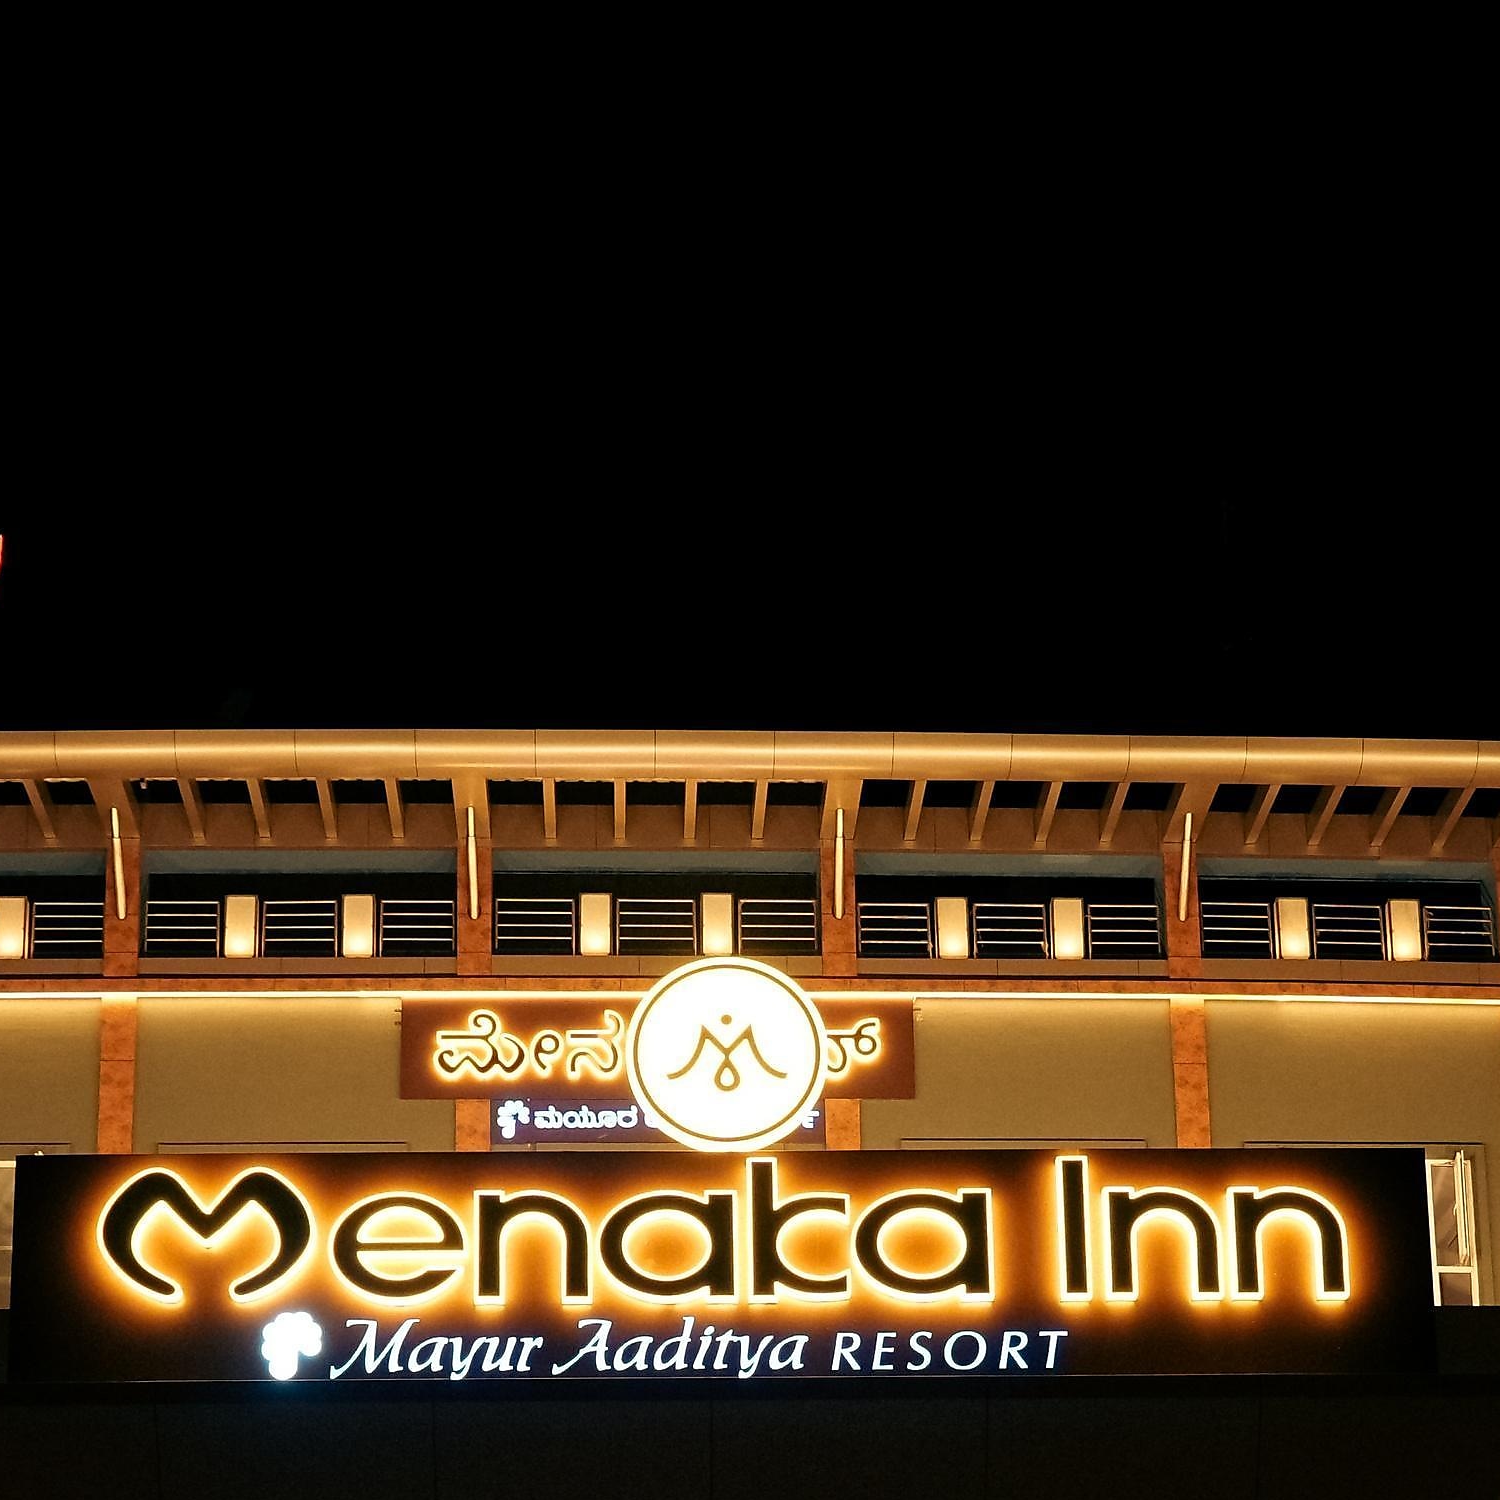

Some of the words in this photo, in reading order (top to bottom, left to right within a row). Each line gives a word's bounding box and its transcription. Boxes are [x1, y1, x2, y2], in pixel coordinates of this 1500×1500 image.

[433, 1009, 625, 1080] ಮೇನ
[533, 1104, 639, 1130] ಮಯೂರ
[97, 1157, 995, 1304] Menaka
[1055, 1154, 1350, 1301] Inn
[329, 1318, 547, 1381] Mayur
[551, 1316, 809, 1379] Aaditya
[831, 1330, 1069, 1371] RESORT
